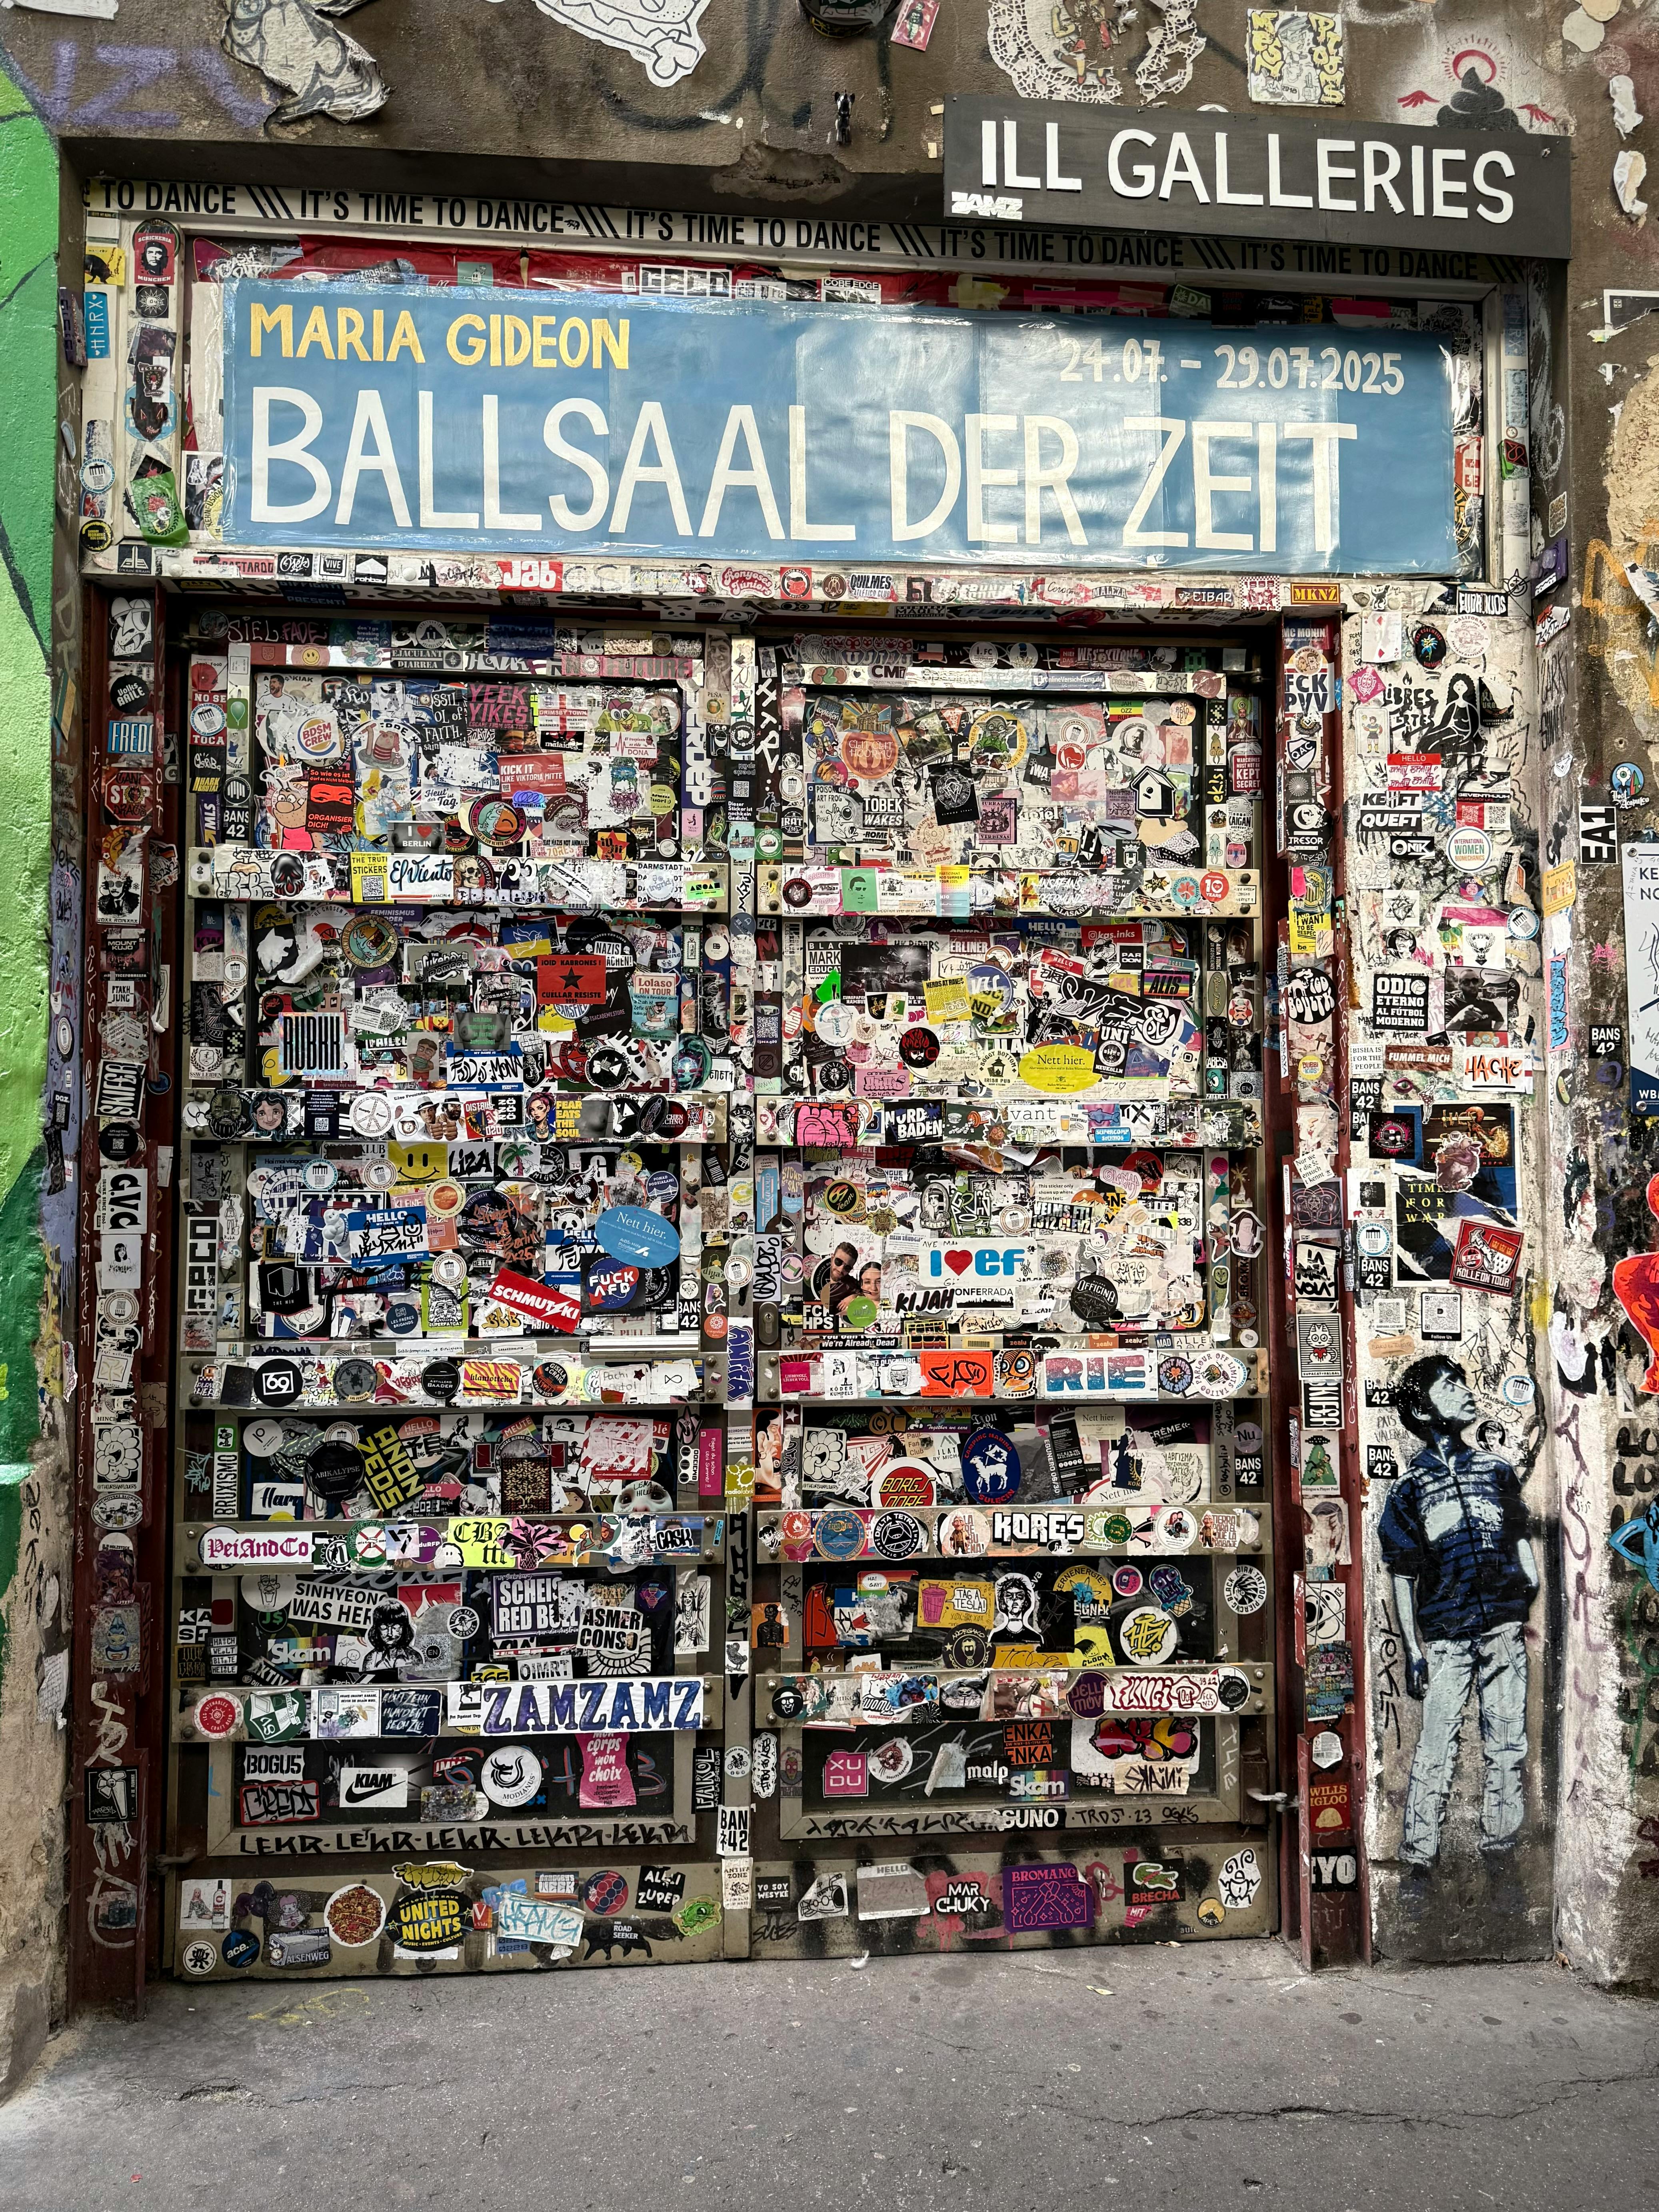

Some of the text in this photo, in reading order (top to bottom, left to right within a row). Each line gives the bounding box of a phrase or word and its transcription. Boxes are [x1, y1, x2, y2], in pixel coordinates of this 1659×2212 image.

[981, 120, 1515, 224] ILL GALLERIES
[103, 179, 236, 214] TO DANCE
[300, 190, 564, 232] IT'S TIME TO DANCE
[626, 209, 881, 252] IT'S TIME TO DANCE
[939, 228, 1183, 267] IT'S TIME TO DANCE
[1240, 241, 1479, 280] IT'S TIME TO DANCE
[250, 302, 630, 370] MARIA GIDEON
[1059, 337, 1405, 396] 24.07. - 29.07.2025
[250, 386, 1357, 552] BALLSAAL DER ZEIT
[326, 560, 341, 569] VIVE
[851, 574, 891, 589] QUILMES
[1092, 585, 1127, 599] MALEZA
[1193, 590, 1233, 603] EIBAR
[1294, 587, 1337, 601] MKNŽ
[1283, 629, 1295, 637] MC
[391, 650, 443, 659] EJACULANT
[397, 660, 438, 669] DIARREA
[1285, 673, 1328, 692] FCK
[194, 693, 210, 703] NO
[467, 683, 526, 705] YEEK
[1285, 693, 1328, 712] PVV
[471, 704, 527, 724] YIKES
[192, 735, 225, 745] TOCA
[305, 730, 332, 748] CREW
[500, 763, 534, 775] KICK IT
[1236, 769, 1260, 780] KEPT
[501, 772, 563, 783] LIKE VIKTORIA MITTE
[1236, 779, 1261, 789] SECRET
[863, 797, 903, 813] TOBEK
[223, 809, 250, 823] BANS
[863, 813, 903, 827] WAKES
[1361, 813, 1421, 828] QUEFT
[226, 824, 245, 838] 42
[1288, 836, 1323, 846] TRESOR
[1454, 844, 1485, 855] WOMEN
[352, 866, 388, 875] STICKERS
[1028, 922, 1066, 931] HELLO
[1302, 914, 1325, 925] WANT
[1097, 929, 1135, 940] kas.inks
[596, 943, 620, 954] NAZIS
[638, 977, 673, 988] Lolaso
[1148, 975, 1183, 996] ALIS
[639, 987, 672, 996] ON TOUR
[1376, 997, 1425, 1007] ETERNO
[1390, 1006, 1425, 1017] FÚTBOL
[1376, 1017, 1425, 1027] MODERNO
[1591, 1028, 1621, 1041] BANS
[1036, 1054, 1086, 1066] Nett hier.
[1388, 1052, 1450, 1063] FUMMEL MICH
[1351, 1081, 1380, 1095] BANS
[556, 1100, 582, 1110] FEAR
[1355, 1095, 1375, 1109] 42
[556, 1128, 581, 1138] SOUL
[897, 1120, 943, 1138] BADEN
[616, 1211, 642, 1230] Nett
[642, 1222, 667, 1241] hier.
[930, 1249, 1025, 1277] I ef
[589, 1270, 635, 1287] FUCK
[894, 1288, 954, 1314] KIJAH
[822, 1338, 895, 1349] We're Already Dead
[1045, 1356, 1146, 1392] RIE
[266, 1374, 290, 1393] 69
[1235, 1458, 1261, 1471] BANS
[214, 1453, 238, 1517] BRUXISMO
[1239, 1471, 1258, 1485] 42
[994, 1513, 1084, 1545] KORES
[656, 1528, 695, 1551] CASK
[955, 1600, 986, 1613] TESLA!
[482, 1681, 702, 1734] ZAMZAMZ
[1004, 1723, 1051, 1742] ENKA
[1309, 1784, 1347, 1796] WILLS
[720, 1814, 748, 1831] BAN
[948, 1882, 979, 1897] MAR
[1131, 1890, 1180, 1904] BRECHA
[400, 1899, 459, 1922] UNITED
[935, 1896, 991, 1914] CHUKY
[401, 1918, 462, 1940] NIGHTS
[612, 1931, 639, 1940] SEEKER
[613, 1924, 632, 1933] ROAD
[286, 1951, 329, 1965] ALSENWEG
